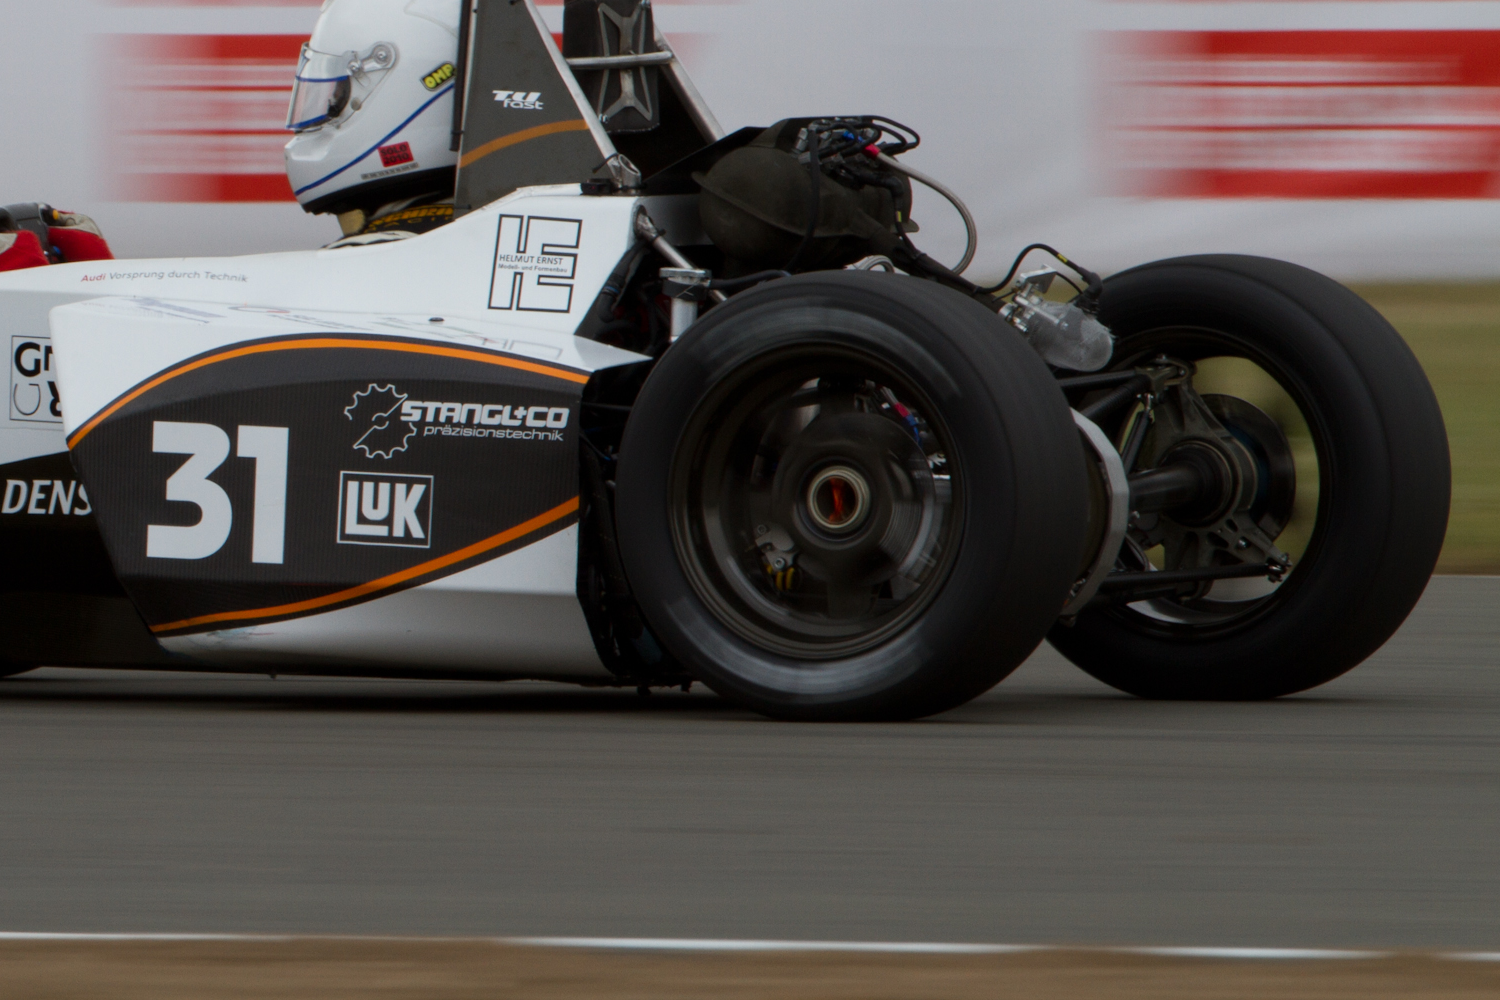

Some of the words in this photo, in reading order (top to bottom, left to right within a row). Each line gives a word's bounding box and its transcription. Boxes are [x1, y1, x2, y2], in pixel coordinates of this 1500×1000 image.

[423, 63, 456, 89] OMP
[503, 99, 544, 110] fast
[499, 254, 534, 264] HELMUT
[537, 256, 563, 265] ERNST
[81, 273, 106, 282] Audi
[109, 271, 165, 281] Vorsprung
[167, 270, 200, 279] durch
[204, 271, 248, 283] Technik
[423, 424, 564, 441] präzisionstechnik
[145, 420, 290, 564] 31
